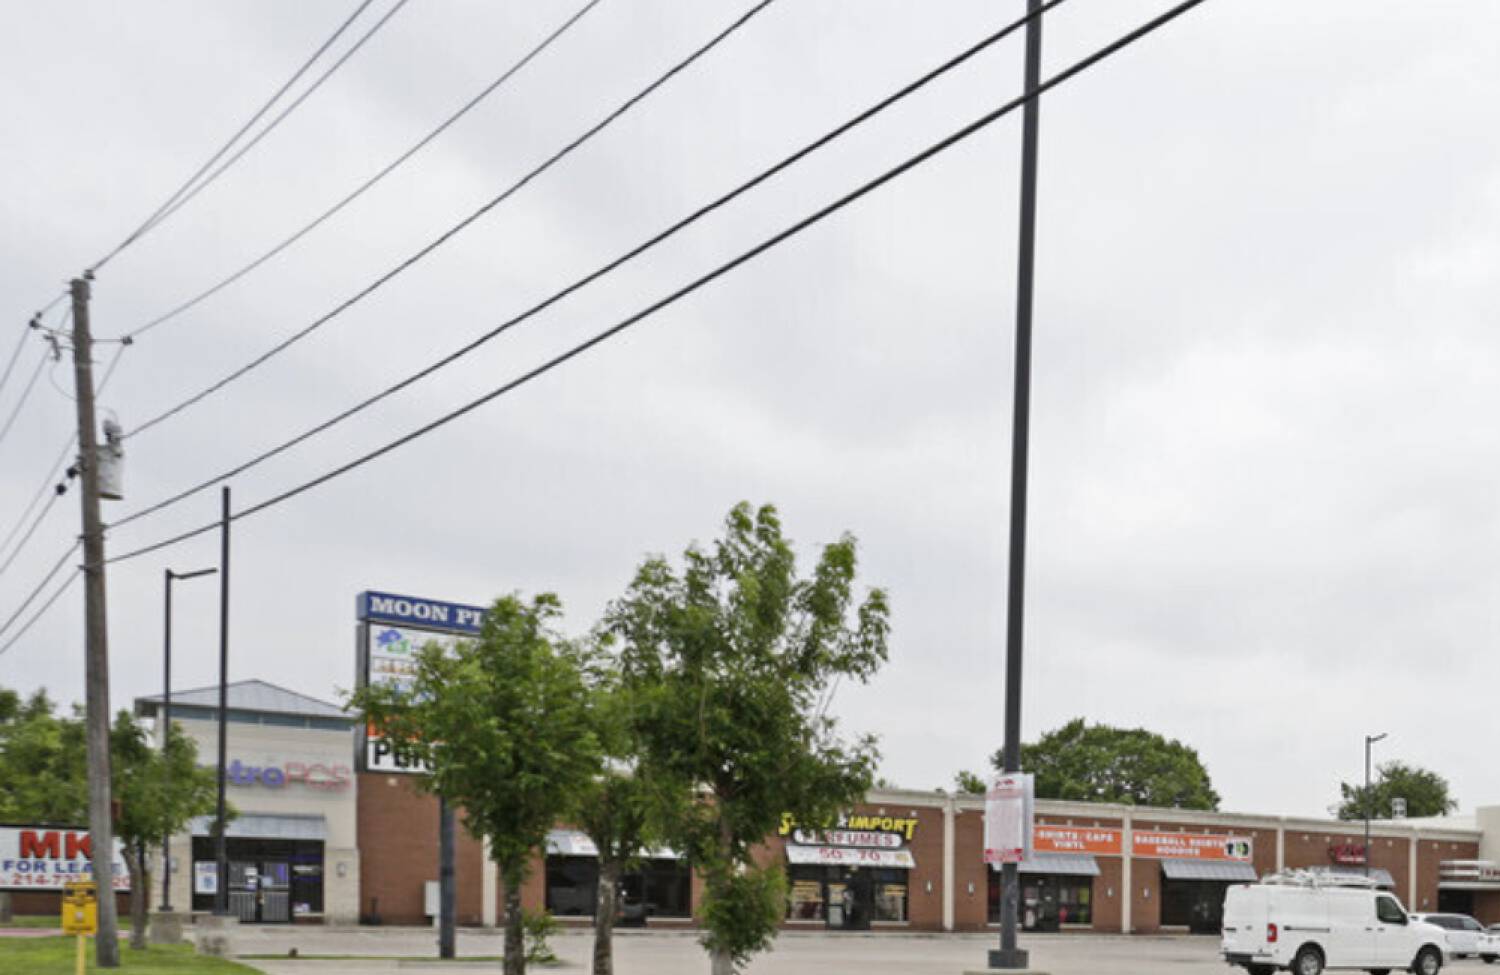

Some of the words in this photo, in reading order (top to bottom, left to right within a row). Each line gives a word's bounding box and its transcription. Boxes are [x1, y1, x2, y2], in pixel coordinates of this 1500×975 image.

[371, 597, 448, 621] MOON
[220, 759, 352, 793] troPCS
[818, 830, 894, 847] RFUMES
[848, 815, 919, 841] IMPORT
[19, 831, 94, 859] MK
[3, 860, 47, 873] FOR
[54, 861, 121, 875] LEAE
